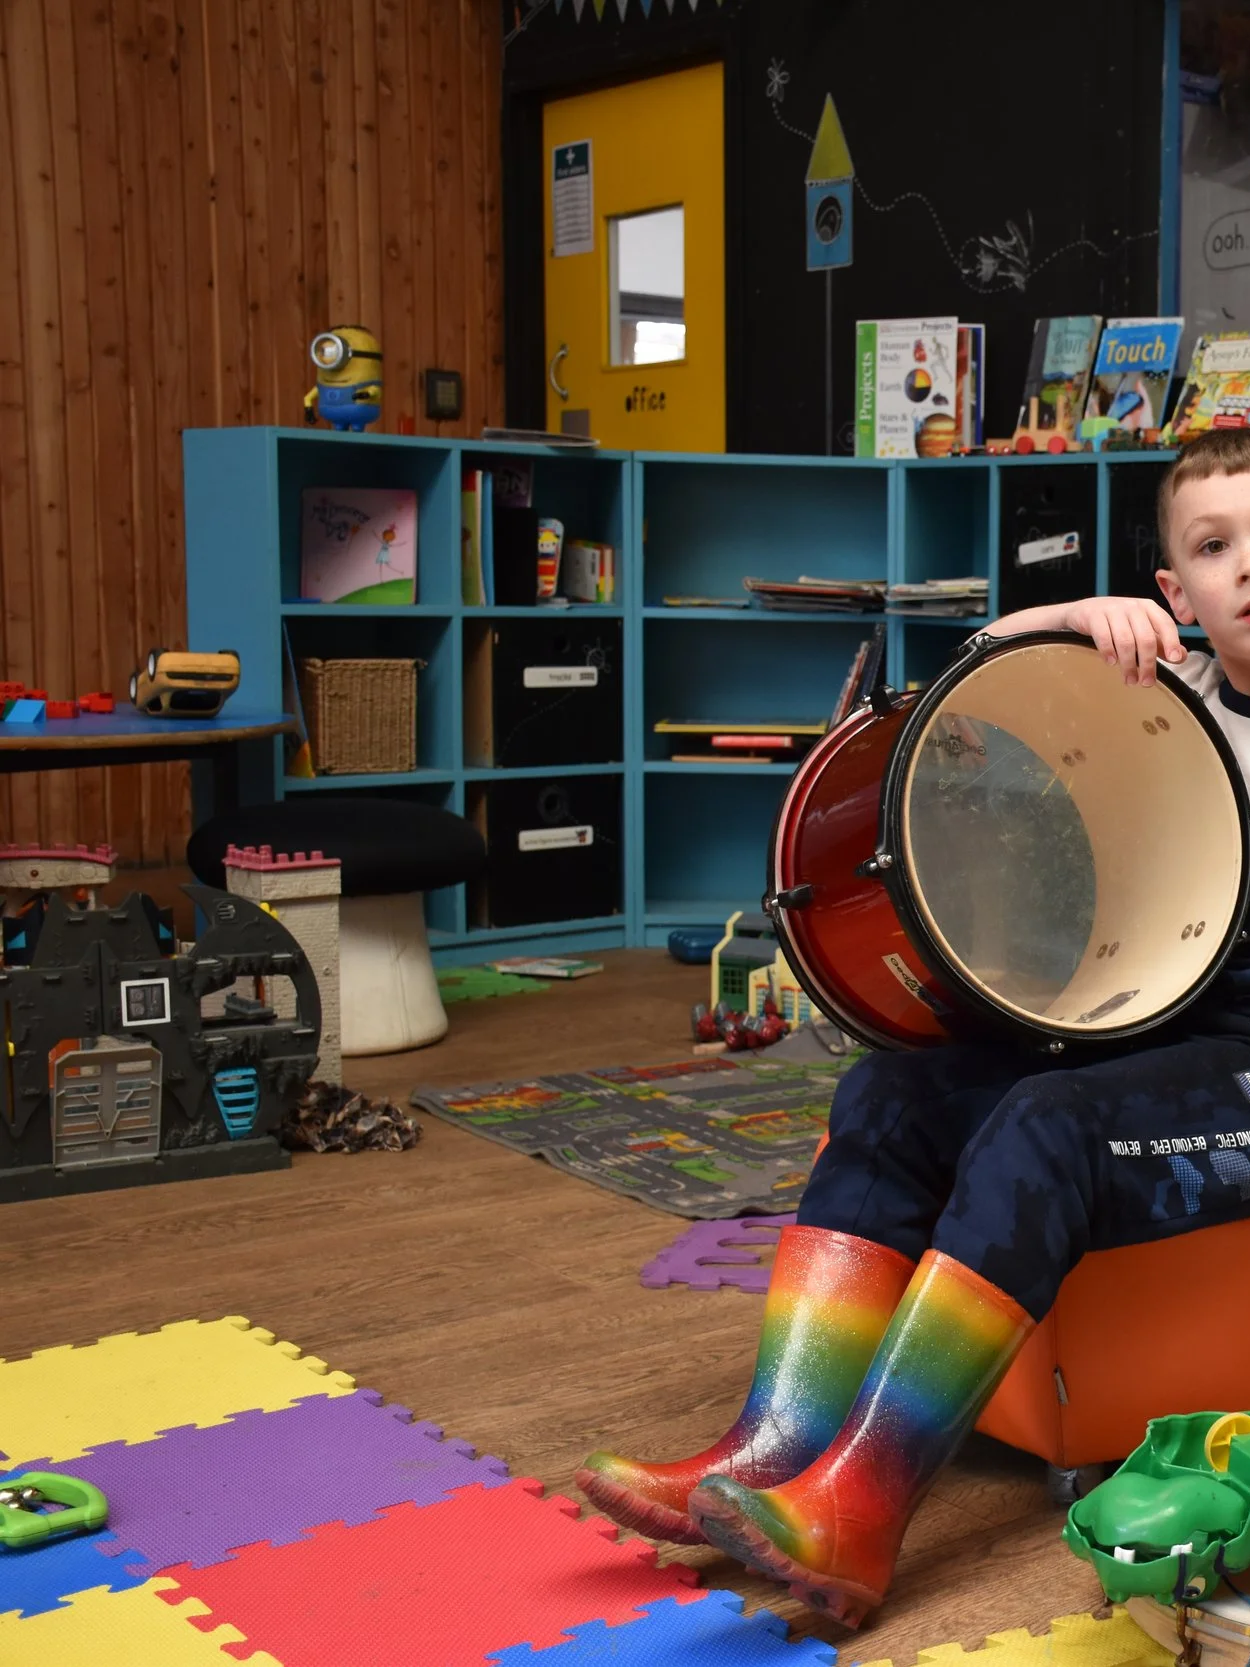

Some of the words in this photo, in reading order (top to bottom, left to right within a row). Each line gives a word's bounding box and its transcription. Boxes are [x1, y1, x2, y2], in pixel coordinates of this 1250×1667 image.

[1105, 335, 1167, 365] Touch
[860, 352, 874, 420] Projects
[625, 386, 667, 412] office
[1149, 1139, 1172, 1155] EPIC
[1171, 1135, 1207, 1152] BEYOND
[1215, 1132, 1237, 1149] EPIC
